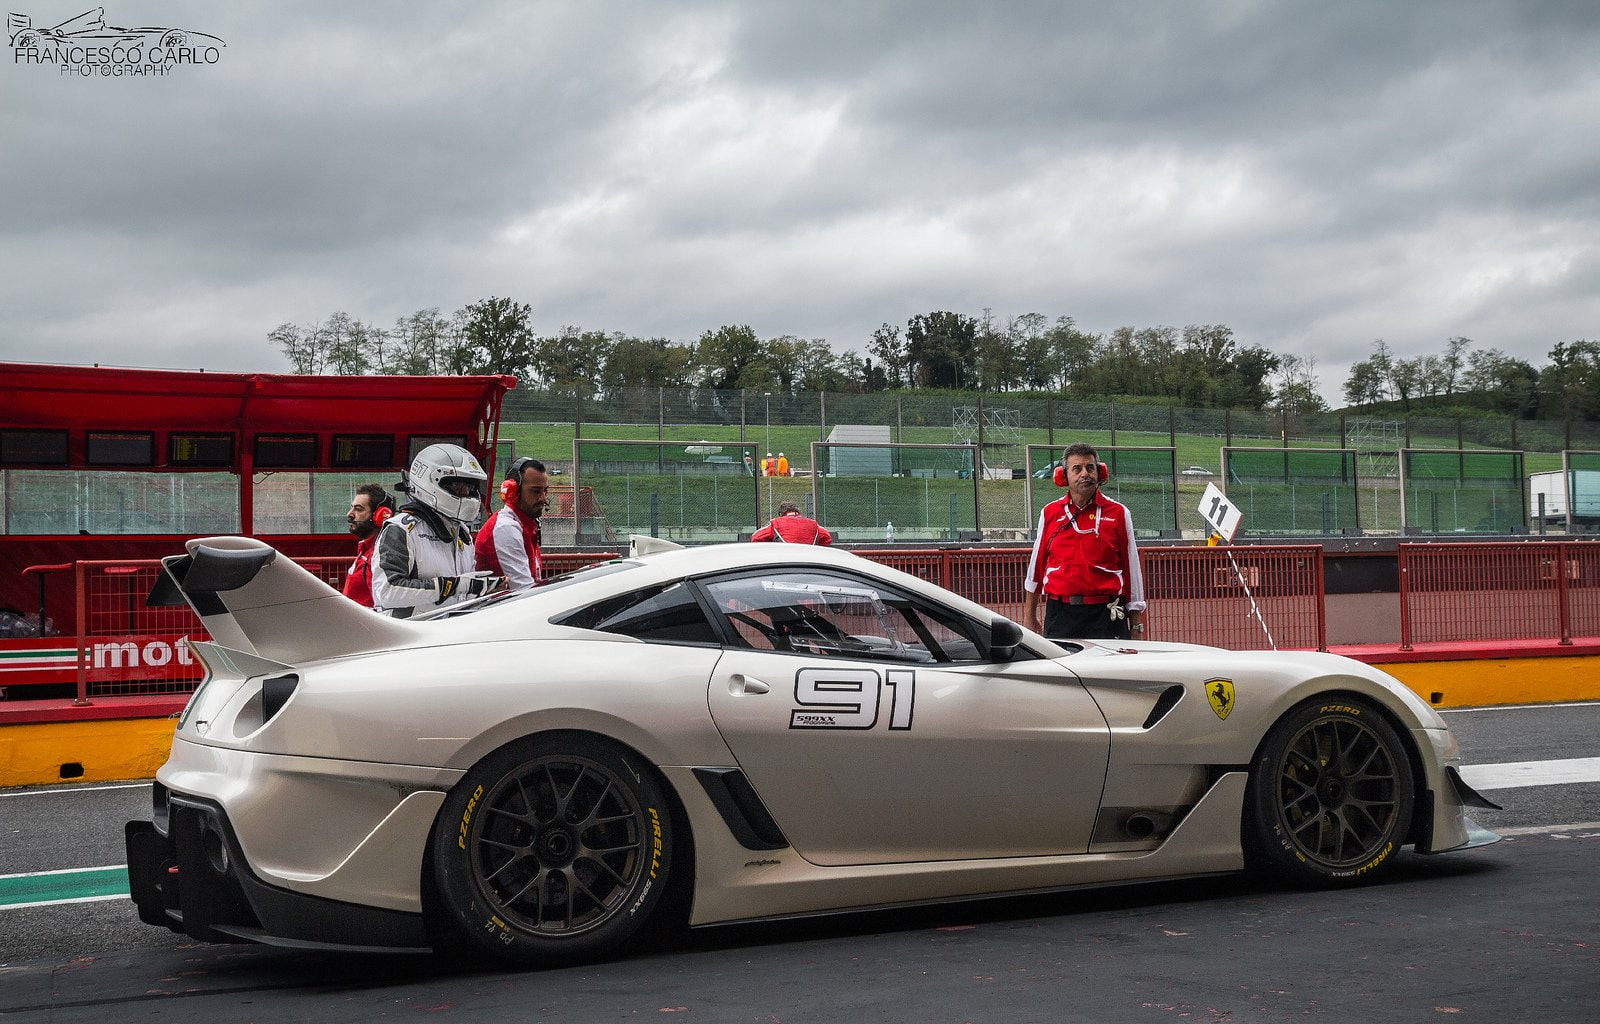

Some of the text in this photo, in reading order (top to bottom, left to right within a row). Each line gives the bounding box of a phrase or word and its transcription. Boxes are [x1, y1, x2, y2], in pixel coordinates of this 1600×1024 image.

[1208, 496, 1228, 528] 11
[94, 634, 194, 668] mot
[789, 667, 916, 731] 91
[1319, 705, 1361, 715] PZERO
[458, 784, 484, 850] PZERO
[648, 807, 662, 879] PIRELLI
[1356, 841, 1393, 876] PIRELLI
